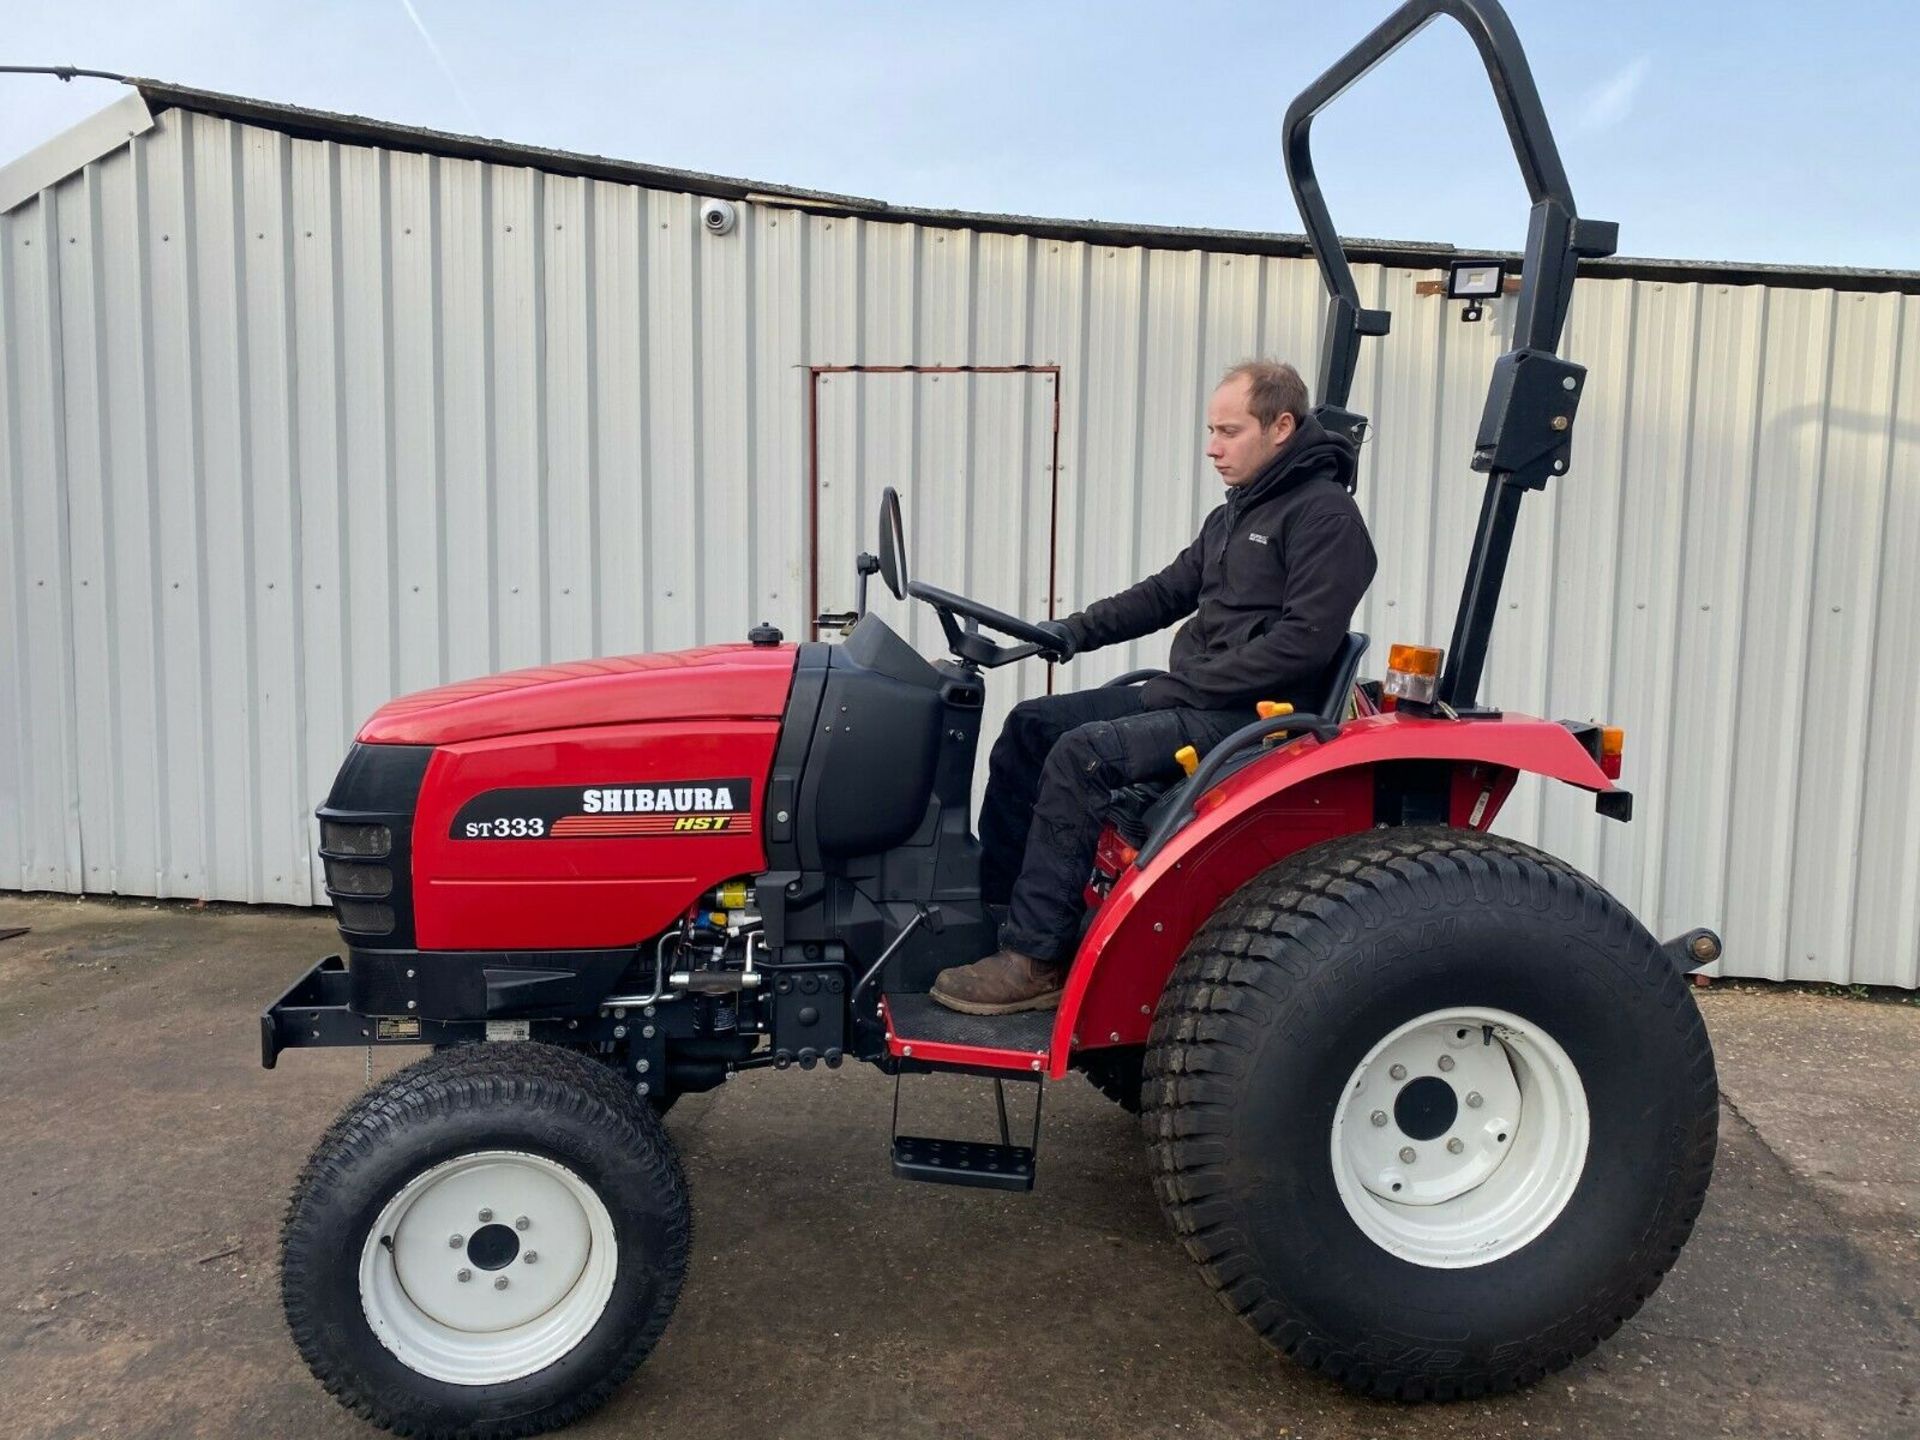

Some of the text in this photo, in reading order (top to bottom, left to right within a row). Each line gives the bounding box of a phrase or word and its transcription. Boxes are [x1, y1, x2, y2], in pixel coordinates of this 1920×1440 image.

[583, 788, 733, 812] SHIBAURA
[674, 817, 730, 830] HST
[1279, 917, 1456, 1045] TITAN
